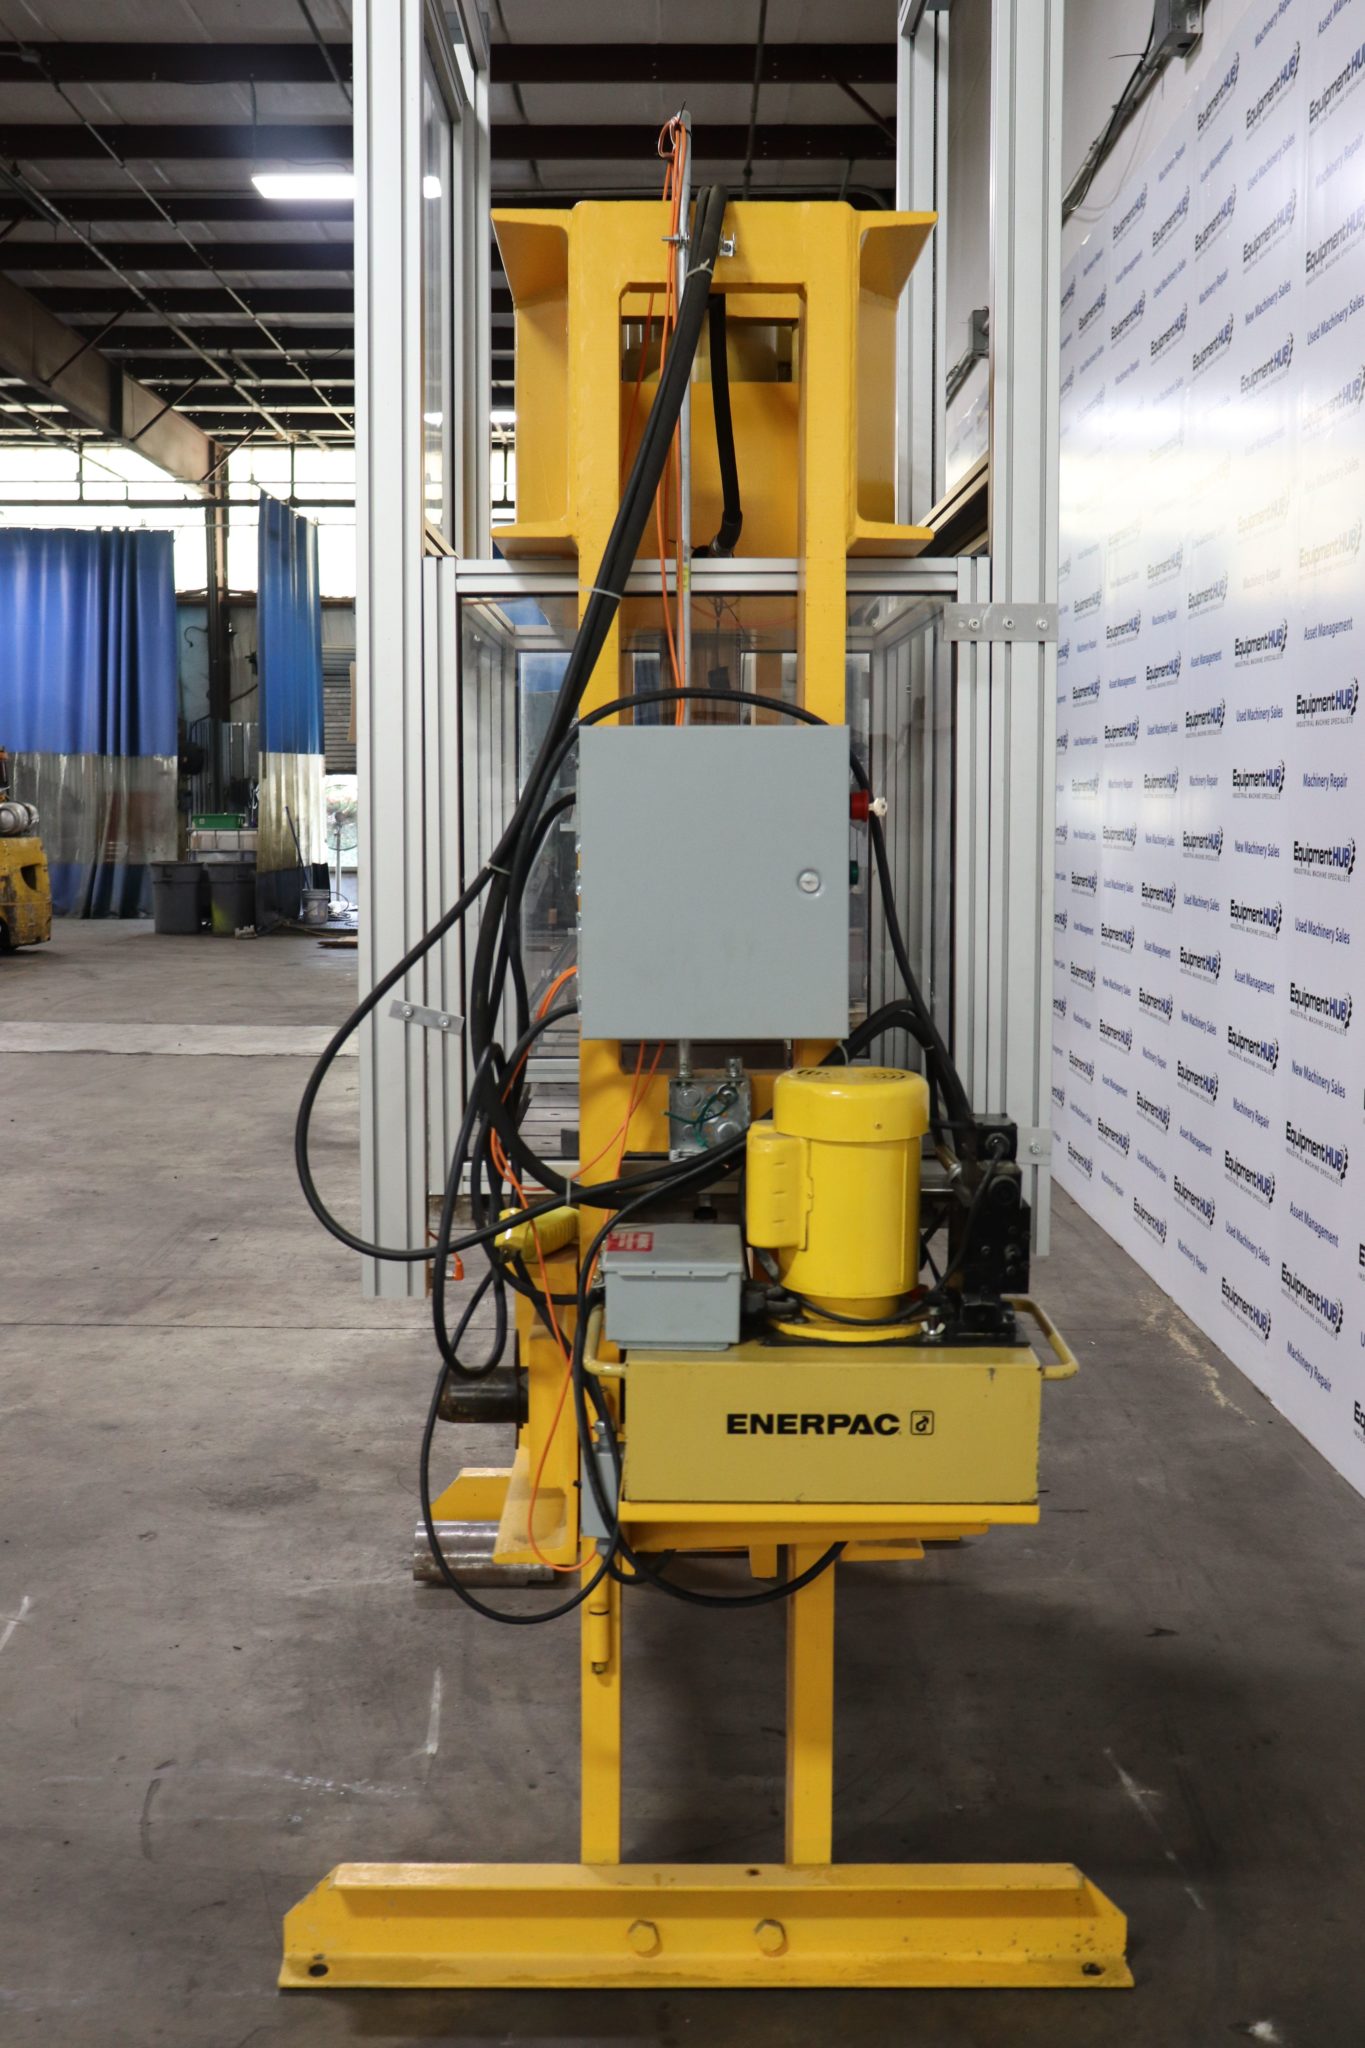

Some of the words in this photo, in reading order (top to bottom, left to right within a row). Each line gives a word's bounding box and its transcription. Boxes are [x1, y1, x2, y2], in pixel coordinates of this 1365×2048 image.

[1309, 43, 1365, 124] EquipmentHU
[1307, 325, 1320, 346] Used
[1320, 307, 1348, 336] Machinery
[1349, 295, 1364, 316] Sales
[1235, 628, 1283, 660] EquipmentHUB
[1304, 627, 1317, 641] Asset
[1318, 617, 1352, 639] Management
[1185, 706, 1222, 729] EquipmentHUB
[1236, 709, 1246, 723] Used
[1247, 707, 1270, 724] Machinery
[1270, 705, 1283, 719] Sales
[1296, 688, 1352, 720] EquipmentHUB
[1232, 768, 1280, 791] EquipmentHUB
[1303, 773, 1329, 791] Machinery
[1330, 773, 1348, 791] Repair
[1183, 830, 1219, 851] EquipmentHUB
[1235, 839, 1244, 853] New
[1244, 841, 1267, 860] Machinery
[1268, 844, 1280, 859] Sales
[1293, 841, 1350, 868] EquipmentHUB
[1192, 895, 1209, 912] Machinery
[1230, 899, 1278, 928] EquipmentHUB
[1295, 918, 1308, 933] Used
[1308, 919, 1335, 945] Machinery
[1335, 926, 1350, 945] Sales
[1180, 946, 1217, 974] EquipmentHUB
[1234, 969, 1245, 984] Asset
[1246, 973, 1275, 995] Management
[1289, 982, 1346, 1021] EquipmentHUB
[1189, 1013, 1206, 1034] Machinery
[1206, 1021, 1217, 1036] Sales
[1228, 1026, 1275, 1063] EquipmentHUB
[1177, 1060, 1215, 1096] EquipmentHUB
[1292, 1060, 1303, 1077] New
[1303, 1065, 1330, 1094] Machinery
[1331, 1078, 1345, 1099] Sales
[1233, 1097, 1255, 1123] Machinery
[1255, 1110, 1270, 1129] Repair
[1285, 1121, 1342, 1173] EquipmentHUB
[1225, 1149, 1271, 1197] EquipmentHUB
[1173, 1175, 1212, 1219] EquipmentHUB
[1289, 1201, 1303, 1222] Asset
[1304, 1211, 1339, 1248] Management
[1225, 1220, 1236, 1239] Used
[1236, 1228, 1258, 1260] Machinery
[1258, 1246, 1270, 1267] Sales
[1221, 1277, 1267, 1332] EquipmentHUB
[1280, 1262, 1338, 1324] EquipmentHUB
[1287, 1341, 1313, 1379] Machinery
[1313, 1365, 1331, 1392] Repair
[727, 1412, 900, 1434] ENERPAC
